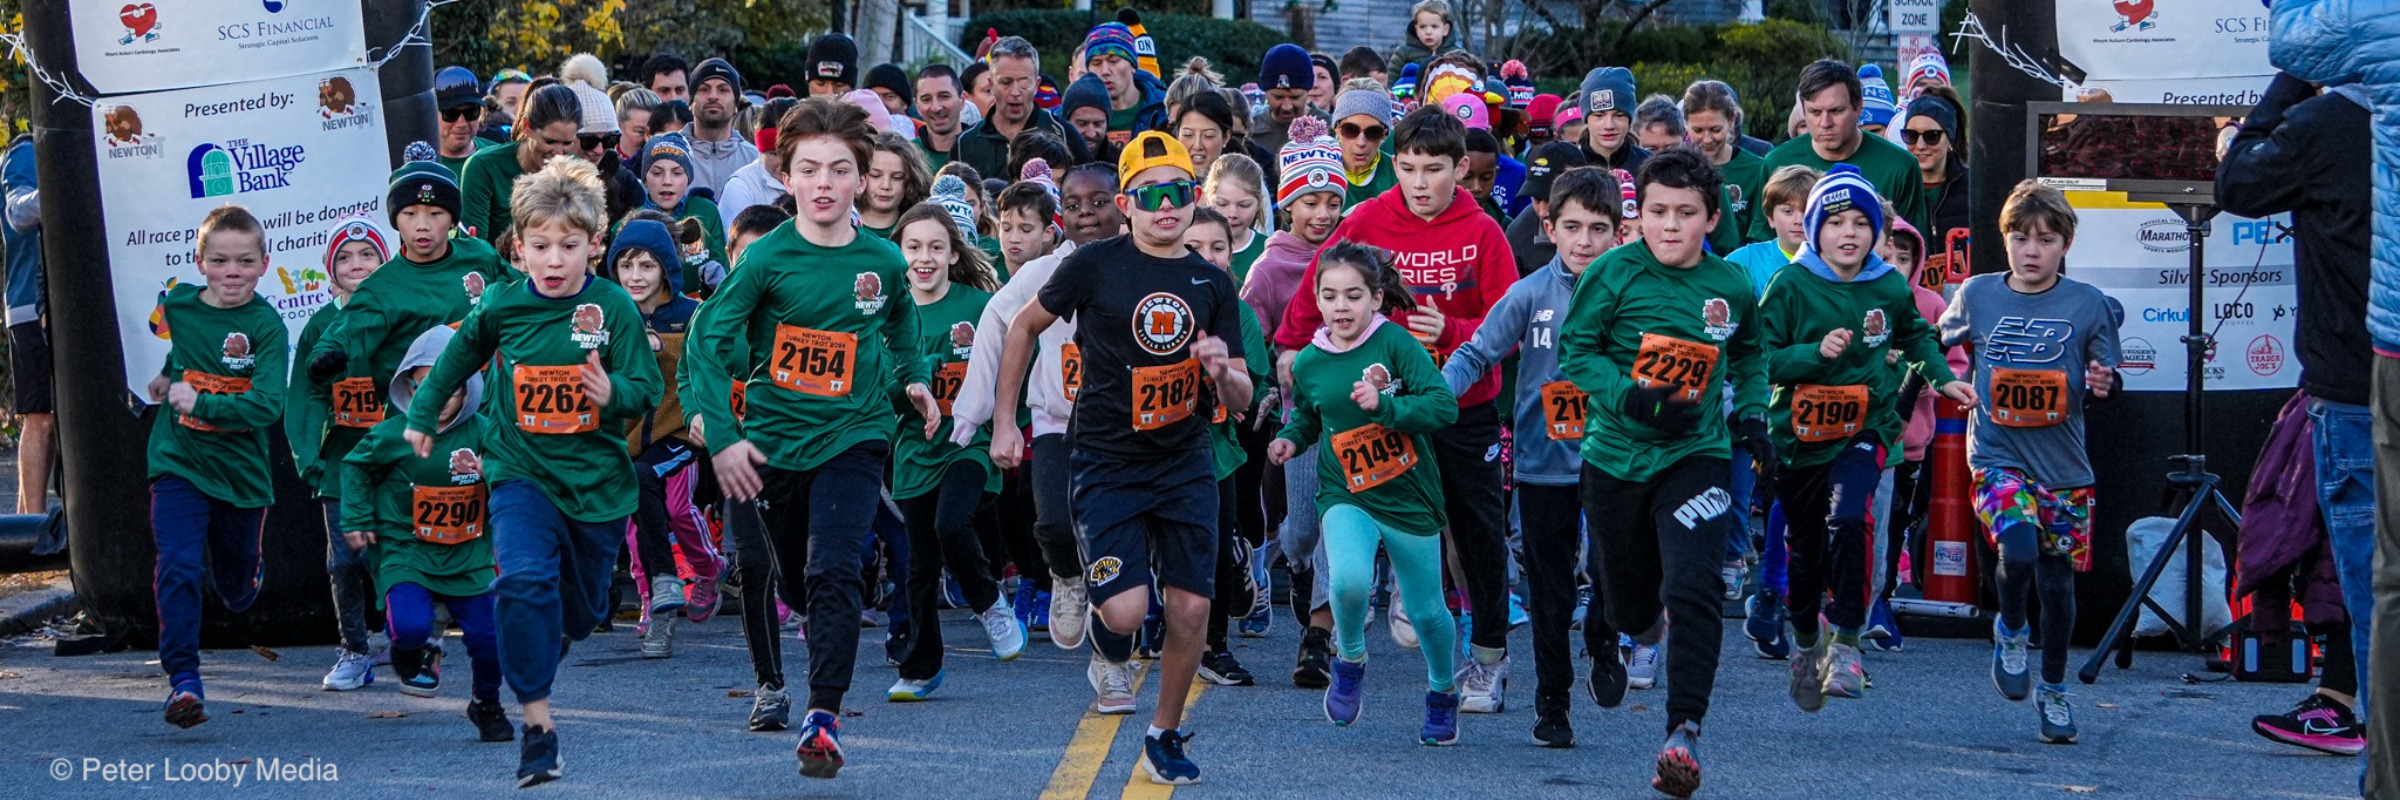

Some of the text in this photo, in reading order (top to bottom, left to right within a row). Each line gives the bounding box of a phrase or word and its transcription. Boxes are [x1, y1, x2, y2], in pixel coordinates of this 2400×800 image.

[1902, 13, 1927, 25] ZONE
[2215, 18, 2246, 33] SCS
[218, 16, 334, 40] SCS FINANCIAL
[238, 41, 265, 49] Strategic
[291, 35, 319, 44] Solutions
[184, 92, 294, 118] Presented by:
[2163, 90, 2245, 104] Presented
[322, 114, 369, 131] NEWTON
[227, 138, 248, 148] THE
[108, 145, 158, 159] NEWTON
[228, 144, 305, 170] Village
[1283, 149, 1342, 166] NEWTON
[238, 167, 290, 193] Bank
[263, 196, 379, 229] will be donated
[127, 229, 145, 246] All
[149, 231, 181, 244] race
[277, 233, 327, 252] chariti
[2140, 229, 2189, 241] MARATHO
[165, 253, 181, 266] to
[1394, 244, 1477, 267] WORLD
[1399, 267, 1457, 284] RIES
[2209, 270, 2282, 287] Sponsors
[1140, 297, 1187, 317] NEWTON
[2215, 302, 2253, 319] LOCO
[1151, 311, 1176, 335] N
[785, 334, 810, 344] TURKEY
[802, 332, 831, 341] NEWTON
[1138, 329, 1188, 350] LITTLE LEAGUE
[1532, 327, 1552, 349] 14
[1652, 344, 1675, 352] TURKEY
[1669, 341, 1697, 351] NEWTON
[778, 341, 846, 378] 2154
[2250, 355, 2280, 363] TRADER
[2254, 362, 2277, 370] JOE'S
[1168, 372, 1184, 381] TROT
[1638, 351, 1707, 387] 2229
[520, 383, 591, 413] 2262
[1140, 372, 1194, 411] 2182
[1995, 383, 2059, 411] 2087
[339, 390, 378, 413] 219
[1797, 399, 1859, 425] 2190
[1341, 432, 1379, 448] TURKEY TROT
[1352, 426, 1379, 438] NEWTON
[1342, 431, 1404, 475] 2149
[417, 500, 480, 527] 2290
